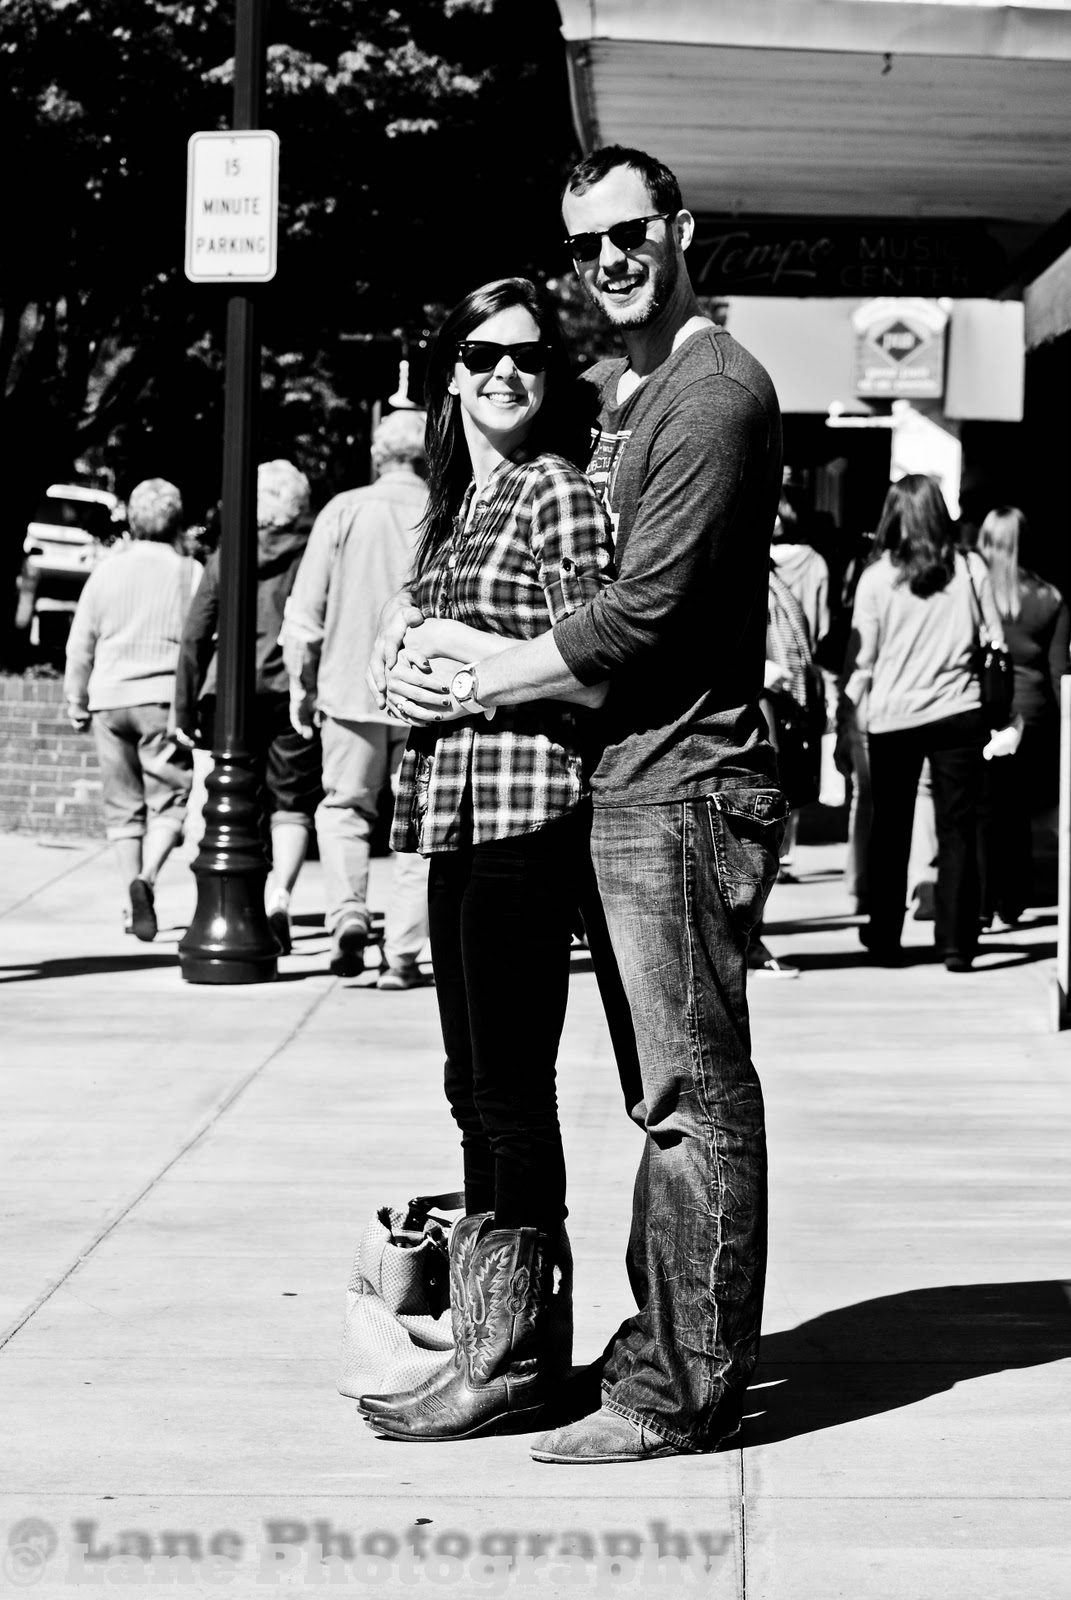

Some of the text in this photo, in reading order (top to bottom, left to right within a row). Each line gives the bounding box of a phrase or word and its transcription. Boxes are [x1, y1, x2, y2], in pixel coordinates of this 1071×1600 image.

[225, 157, 241, 177] 15
[202, 197, 261, 216] MINUTE
[195, 235, 267, 254] PARKING
[858, 235, 961, 261] MUSIC
[840, 264, 969, 288] CENTER
